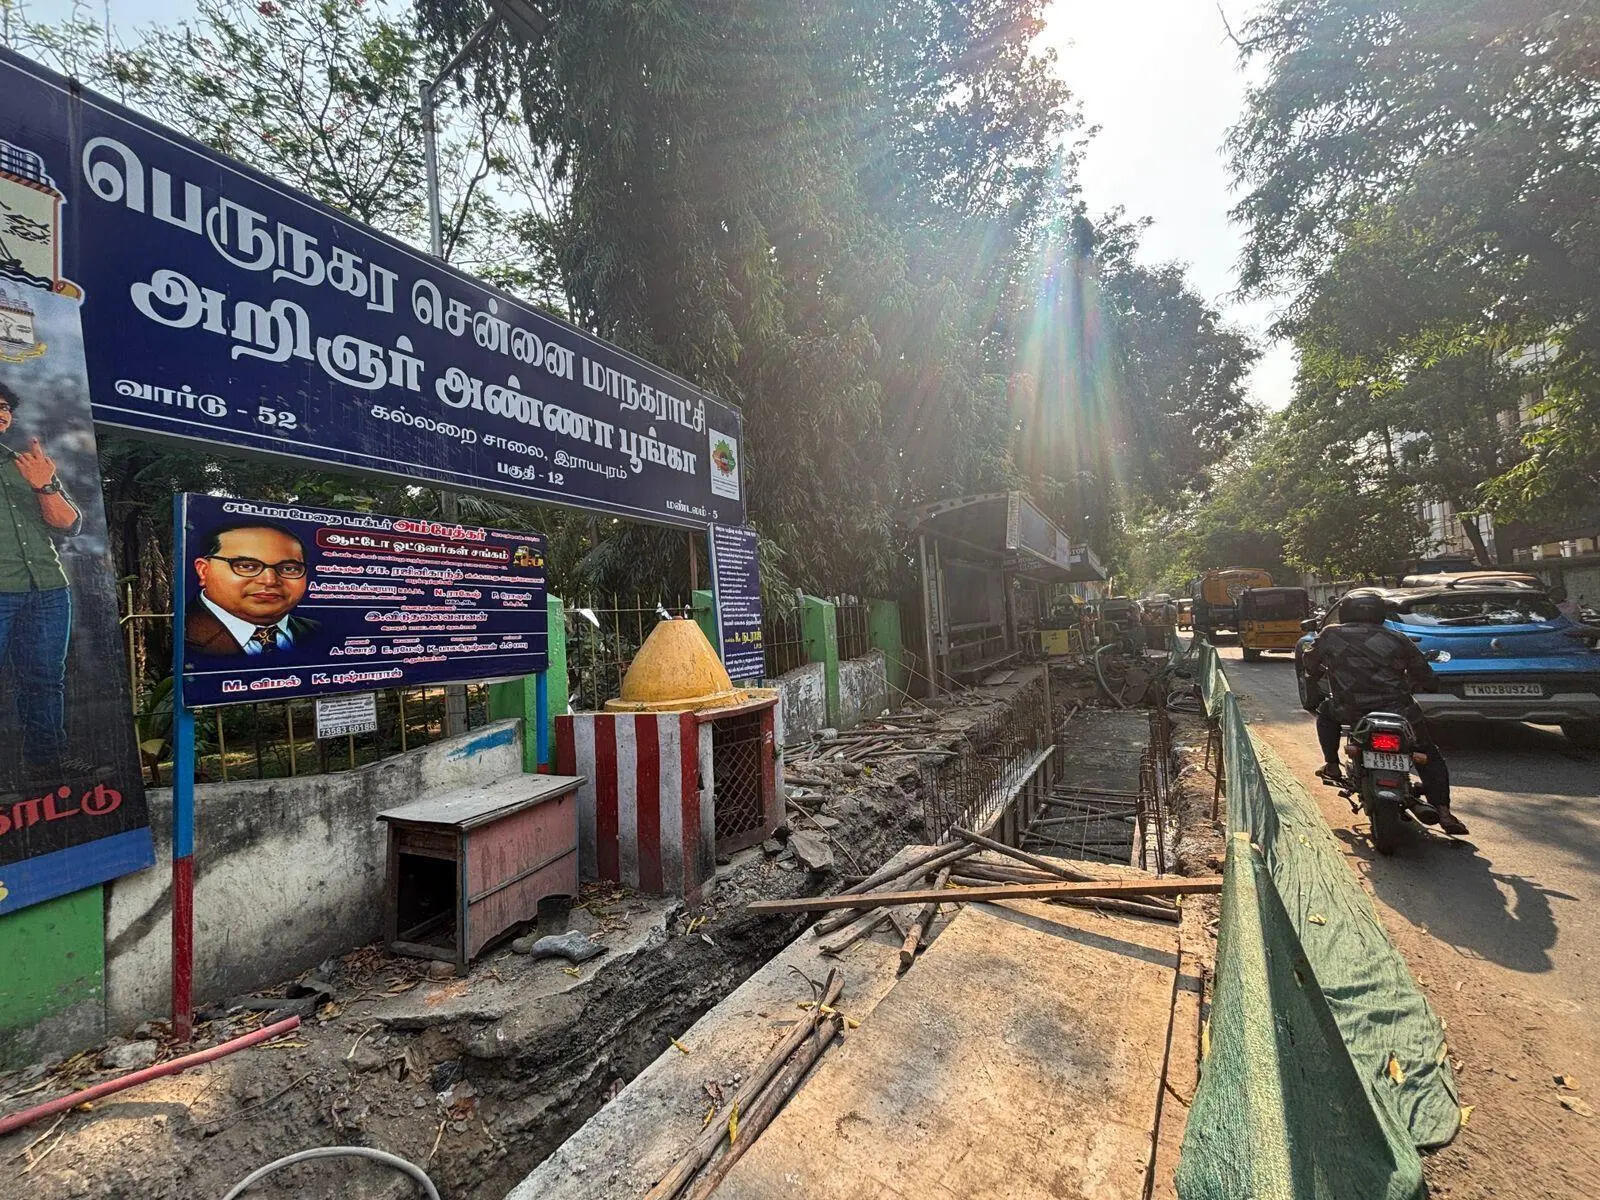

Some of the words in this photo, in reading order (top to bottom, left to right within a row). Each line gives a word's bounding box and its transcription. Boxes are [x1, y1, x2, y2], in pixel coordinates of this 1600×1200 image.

[82, 136, 399, 313] பெருநகர
[411, 279, 575, 380] சென்னை
[582, 356, 706, 435] மாநகராட்சி
[130, 269, 425, 392] அறிஞர்
[435, 367, 614, 449] அண்ணா
[619, 426, 697, 475] பூங்கா
[114, 379, 227, 417] வார்டு
[258, 405, 298, 430] 52
[371, 404, 478, 444] கல்லறை
[482, 433, 548, 462] சாலை,
[553, 450, 628, 481] இராயபுரம்
[497, 461, 535, 483] பகுதி
[547, 469, 564, 486] 12
[223, 502, 341, 525] சட்டமாமேதை
[344, 516, 392, 530] டாக்டர்
[393, 520, 487, 541] அம்பேத்கர்
[666, 498, 707, 517] மண்டலம்
[712, 509, 718, 519] 5
[326, 534, 389, 548] ஆட்டோ
[393, 541, 469, 556] ஓட்டுனர்கள்
[471, 548, 509, 560] சங்கம்
[222, 679, 248, 692] M.
[250, 676, 301, 690] விமல்
[311, 673, 330, 685] K.
